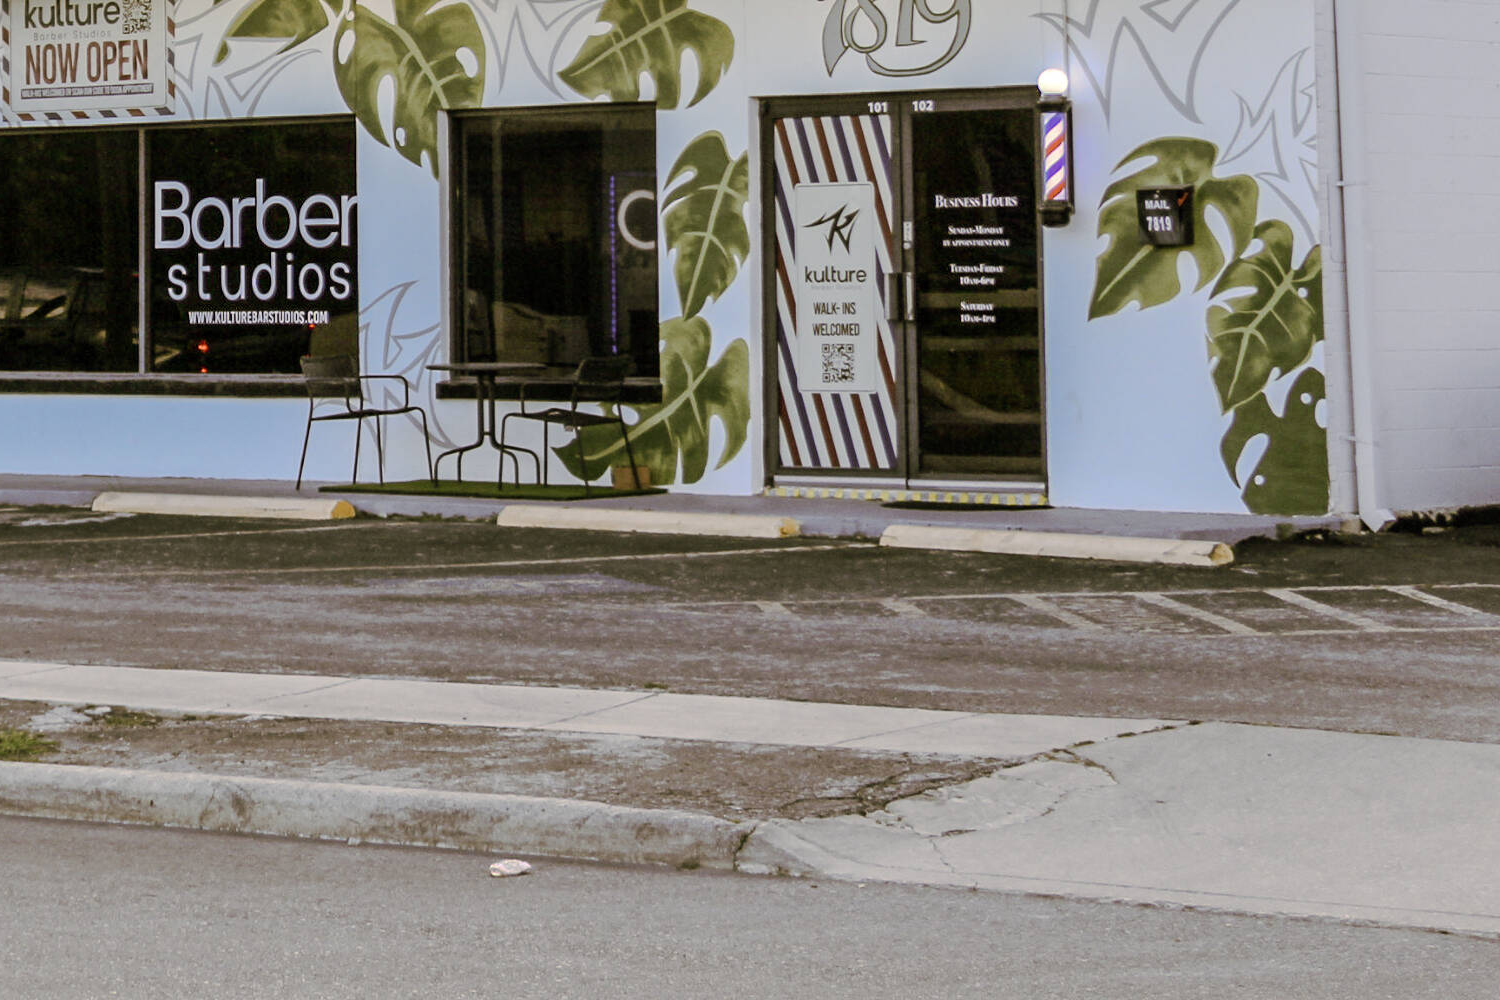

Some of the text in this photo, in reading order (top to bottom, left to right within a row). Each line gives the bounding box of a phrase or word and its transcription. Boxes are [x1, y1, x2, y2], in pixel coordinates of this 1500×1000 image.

[33, 29, 112, 41] Barber Studios
[25, 39, 149, 85] NOW OPEN
[868, 101, 888, 114] 101
[912, 100, 934, 112] 102
[1144, 199, 1170, 209] MAIL
[154, 178, 358, 250] Barber
[1146, 216, 1172, 231] 7819
[167, 251, 351, 301] studios
[804, 265, 867, 283] kulture
[188, 310, 329, 325] WWW.KULTUREBARSTUDIOS.COM
[812, 323, 860, 336] WELCOMED
